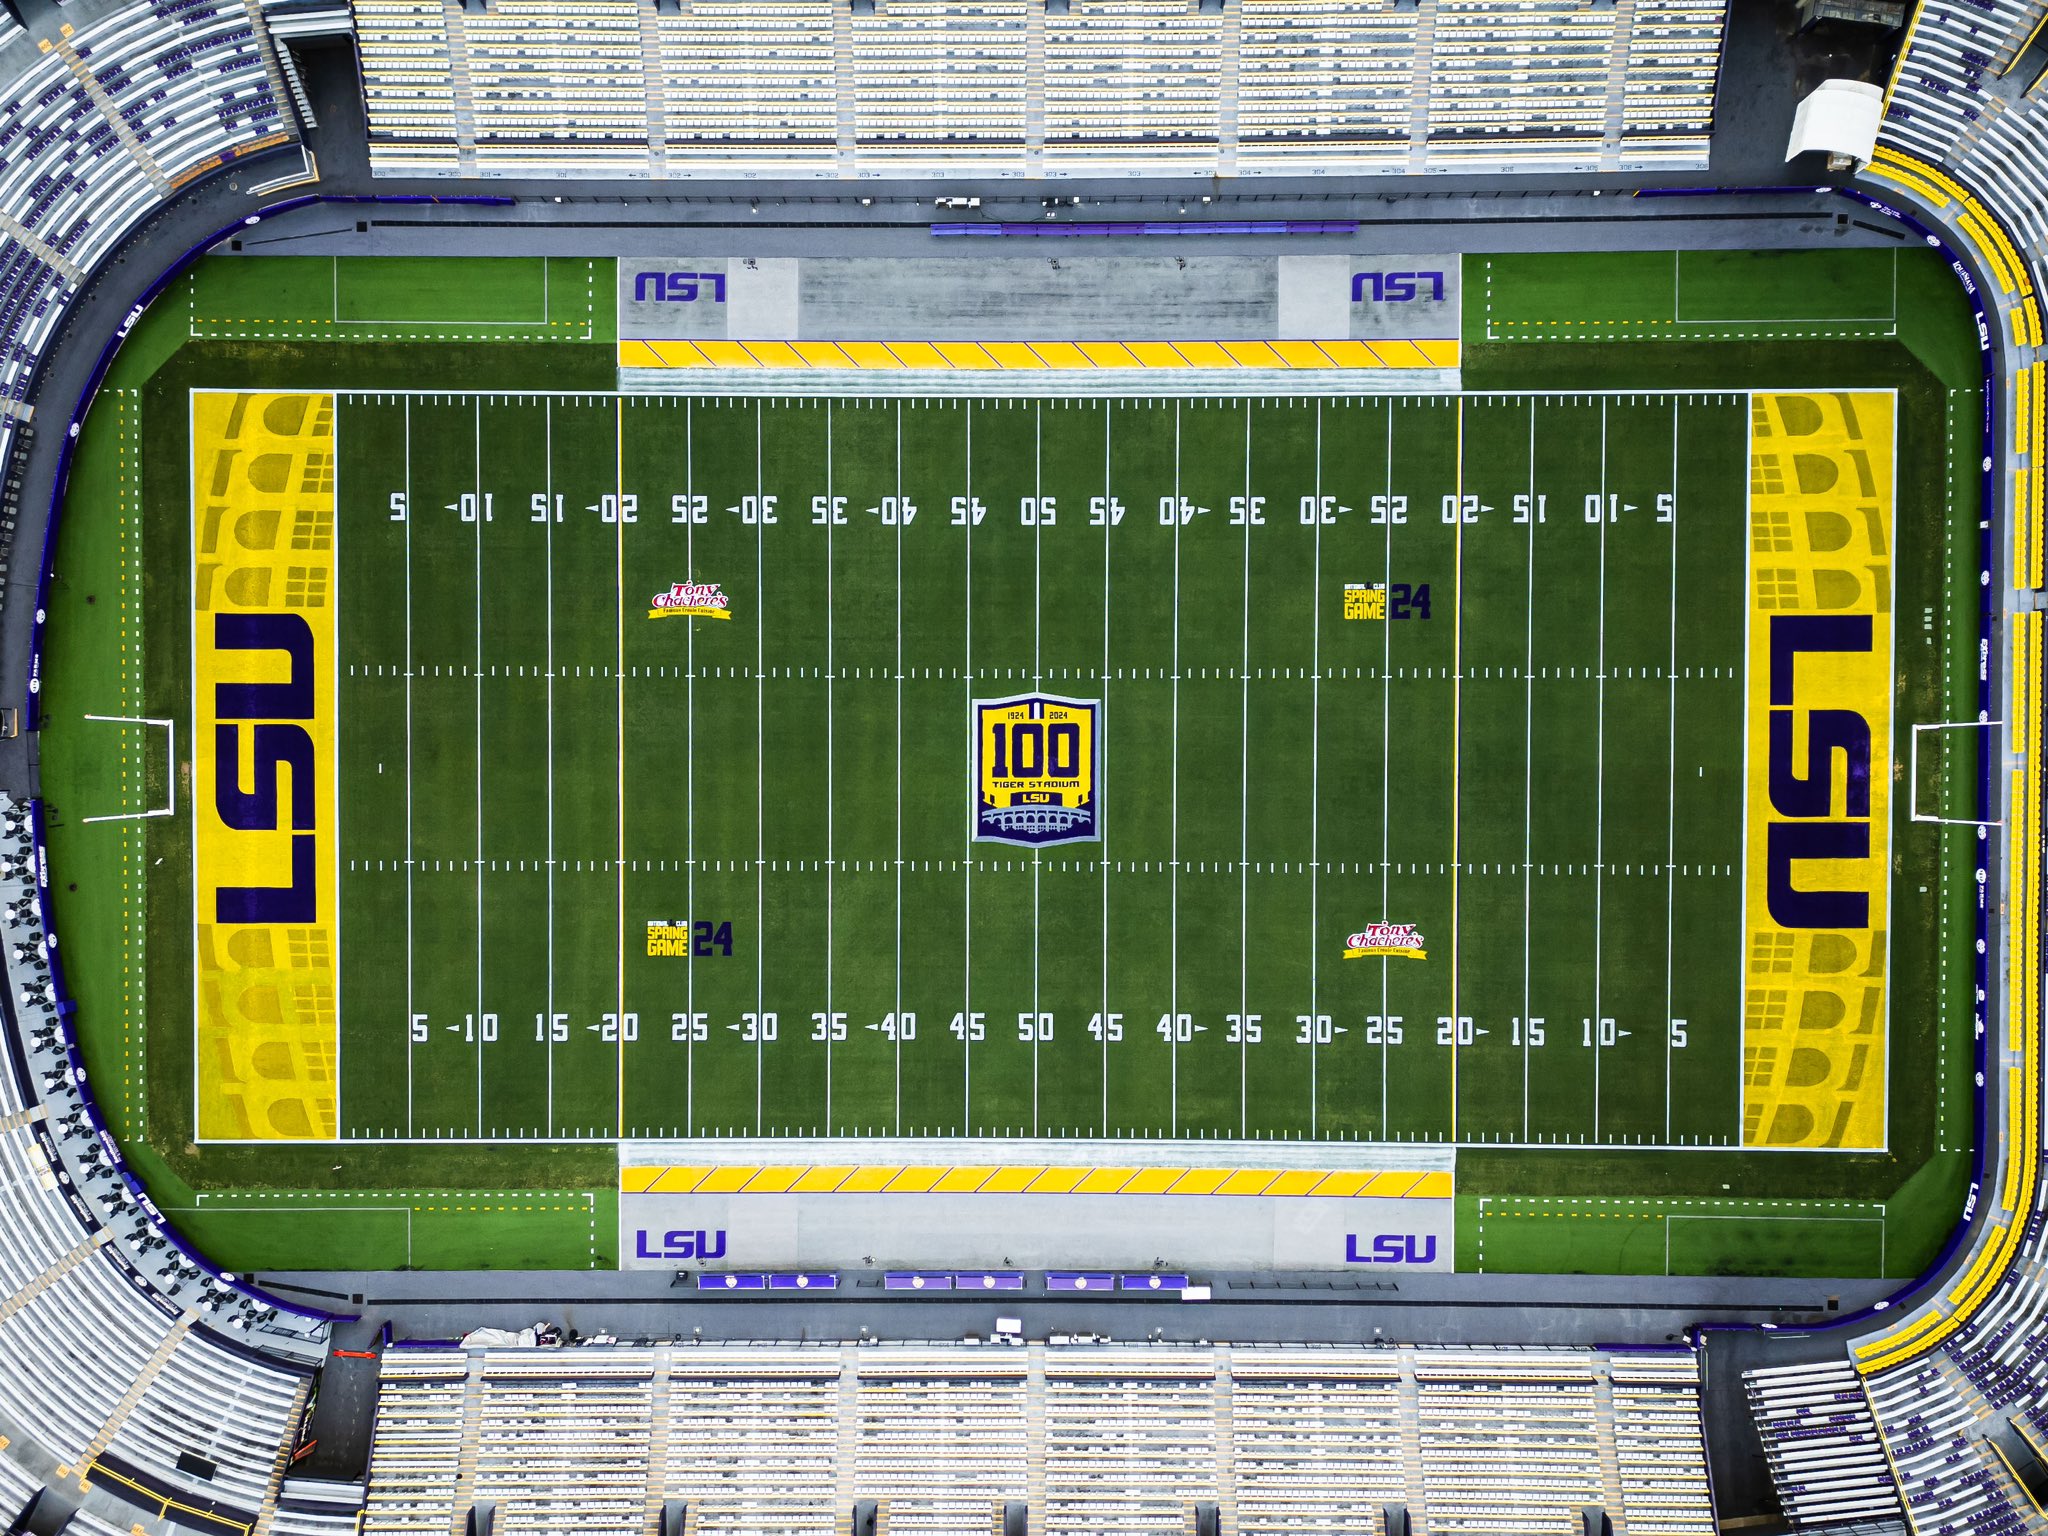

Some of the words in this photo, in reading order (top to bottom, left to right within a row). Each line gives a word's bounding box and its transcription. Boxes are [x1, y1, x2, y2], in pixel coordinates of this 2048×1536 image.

[635, 272, 726, 303] LSU
[1352, 272, 1444, 303] LSU
[117, 304, 145, 338] LSU
[1976, 311, 1990, 351] LSU
[390, 493, 405, 521] 5
[461, 493, 492, 521] 10
[531, 494, 563, 522] 15
[602, 494, 637, 523] 20
[672, 495, 707, 523] 25
[742, 496, 777, 524] 30
[812, 496, 847, 525] 35
[882, 497, 917, 525] 40
[951, 497, 987, 526] 45
[1021, 497, 1056, 526] 50
[1090, 497, 1126, 526] 45
[1160, 497, 1195, 525] 40
[1230, 497, 1265, 525] 35
[1300, 496, 1336, 524] 30
[1371, 496, 1407, 524] 25
[1442, 495, 1478, 523] 20
[1513, 495, 1546, 523] 15
[1585, 494, 1617, 523] 10
[1657, 494, 1672, 522] 5
[671, 580, 720, 598] Tony
[1344, 589, 1385, 603] SPRING
[1391, 583, 1431, 620] 24
[1344, 602, 1385, 620] GAME
[1007, 711, 1024, 720] 1924
[1049, 711, 1068, 720] 2024
[992, 723, 1080, 778] 100
[215, 613, 316, 924] LSU
[1767, 615, 1872, 929] LSU
[1022, 793, 1050, 803] LSU
[1028, 780, 1080, 788] STADIUM
[647, 926, 688, 940] SPRING
[694, 921, 732, 957] 24
[1366, 921, 1416, 937] Tony
[647, 939, 688, 956] GAME
[412, 1014, 427, 1042] 5
[466, 1014, 497, 1042] 10
[536, 1013, 568, 1042] 15
[602, 1013, 638, 1042] 20
[672, 1013, 707, 1041] 25
[742, 1013, 777, 1041] 30
[812, 1013, 847, 1041] 35
[880, 1013, 916, 1041] 40
[949, 1013, 985, 1041] 45
[1019, 1013, 1053, 1041] 50
[1087, 1013, 1123, 1041] 45
[1156, 1014, 1191, 1042] 40
[1226, 1014, 1261, 1043] 35
[1296, 1015, 1331, 1043] 30
[1367, 1016, 1402, 1044] 25
[1437, 1017, 1472, 1045] 20
[1512, 1018, 1544, 1046] 15
[1583, 1018, 1615, 1047] 10
[1672, 1019, 1687, 1047] 5
[137, 1192, 166, 1224] LSU
[1963, 1183, 1979, 1221] LSU
[637, 1230, 726, 1259] LSU
[1346, 1234, 1436, 1264] LSU
